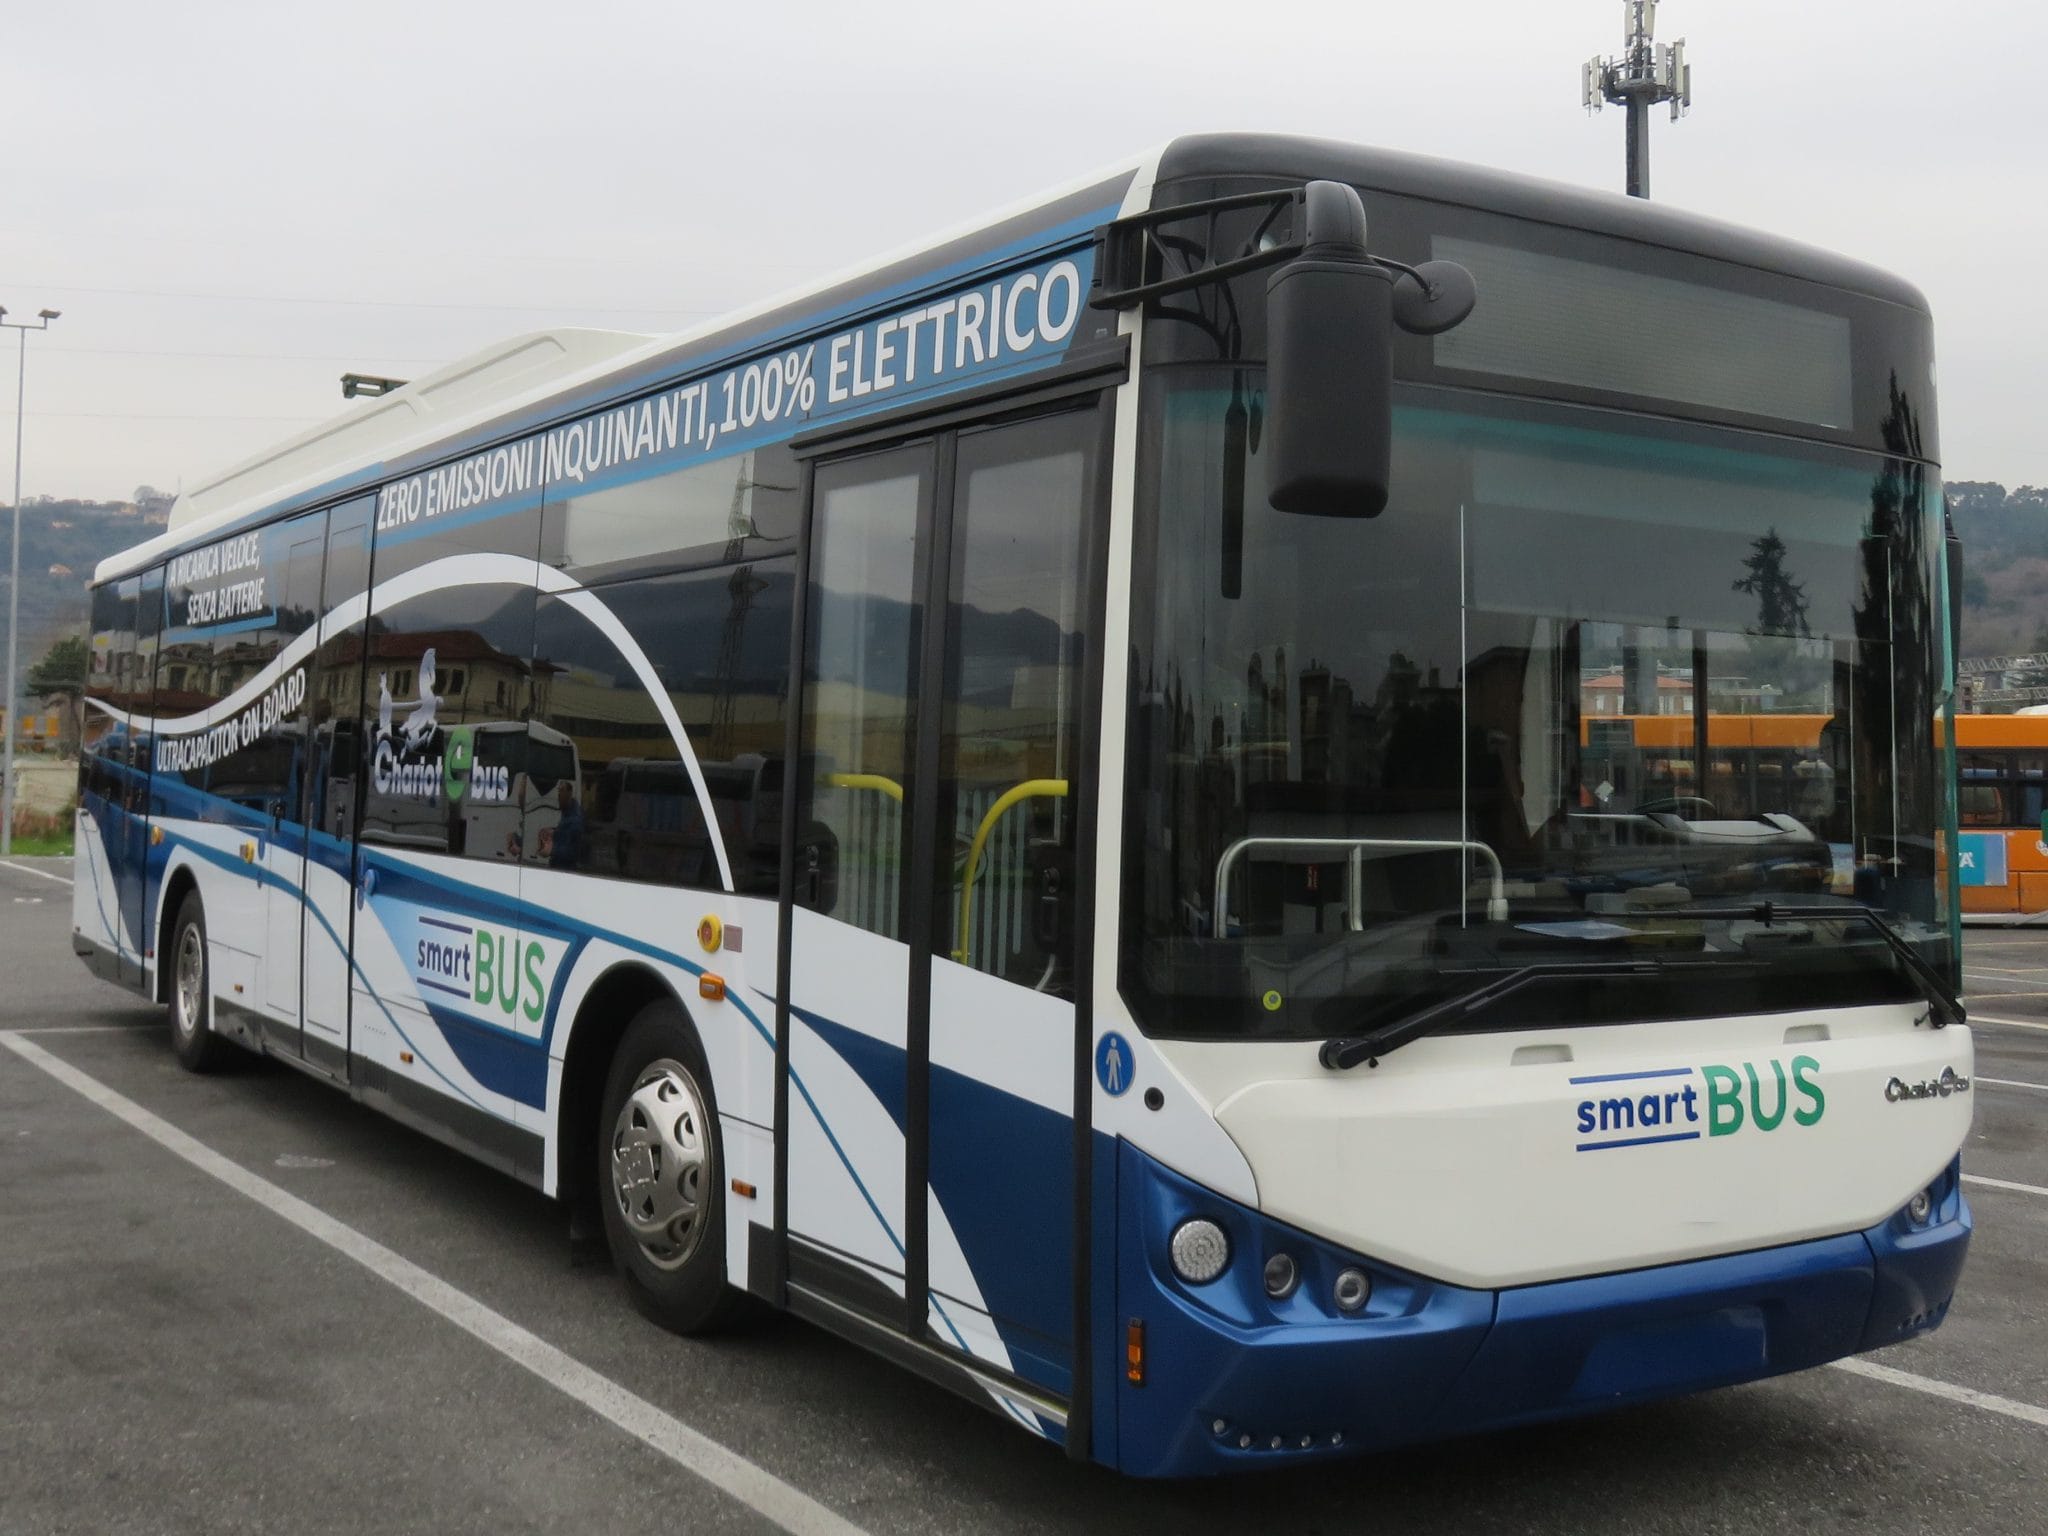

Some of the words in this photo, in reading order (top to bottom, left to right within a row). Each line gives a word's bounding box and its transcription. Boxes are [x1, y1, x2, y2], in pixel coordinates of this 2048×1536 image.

[377, 477, 422, 531] ZERO
[425, 439, 534, 517] EMISSIONI
[538, 381, 716, 483] INQUINANTI,
[719, 343, 816, 433] 100%
[827, 260, 1080, 403] ELETTRICO
[177, 546, 219, 586] RICARICA
[187, 590, 217, 626] SENZA
[218, 577, 265, 619] BATTERIE
[157, 718, 239, 772] ULTRACAPACITOR
[241, 703, 261, 747] ON
[262, 667, 306, 732] BOARD
[471, 755, 509, 801] bus
[417, 936, 472, 982] smart
[474, 929, 546, 1022] BUS
[1576, 1084, 1699, 1134] smart
[1701, 1055, 1825, 1137] BUS
